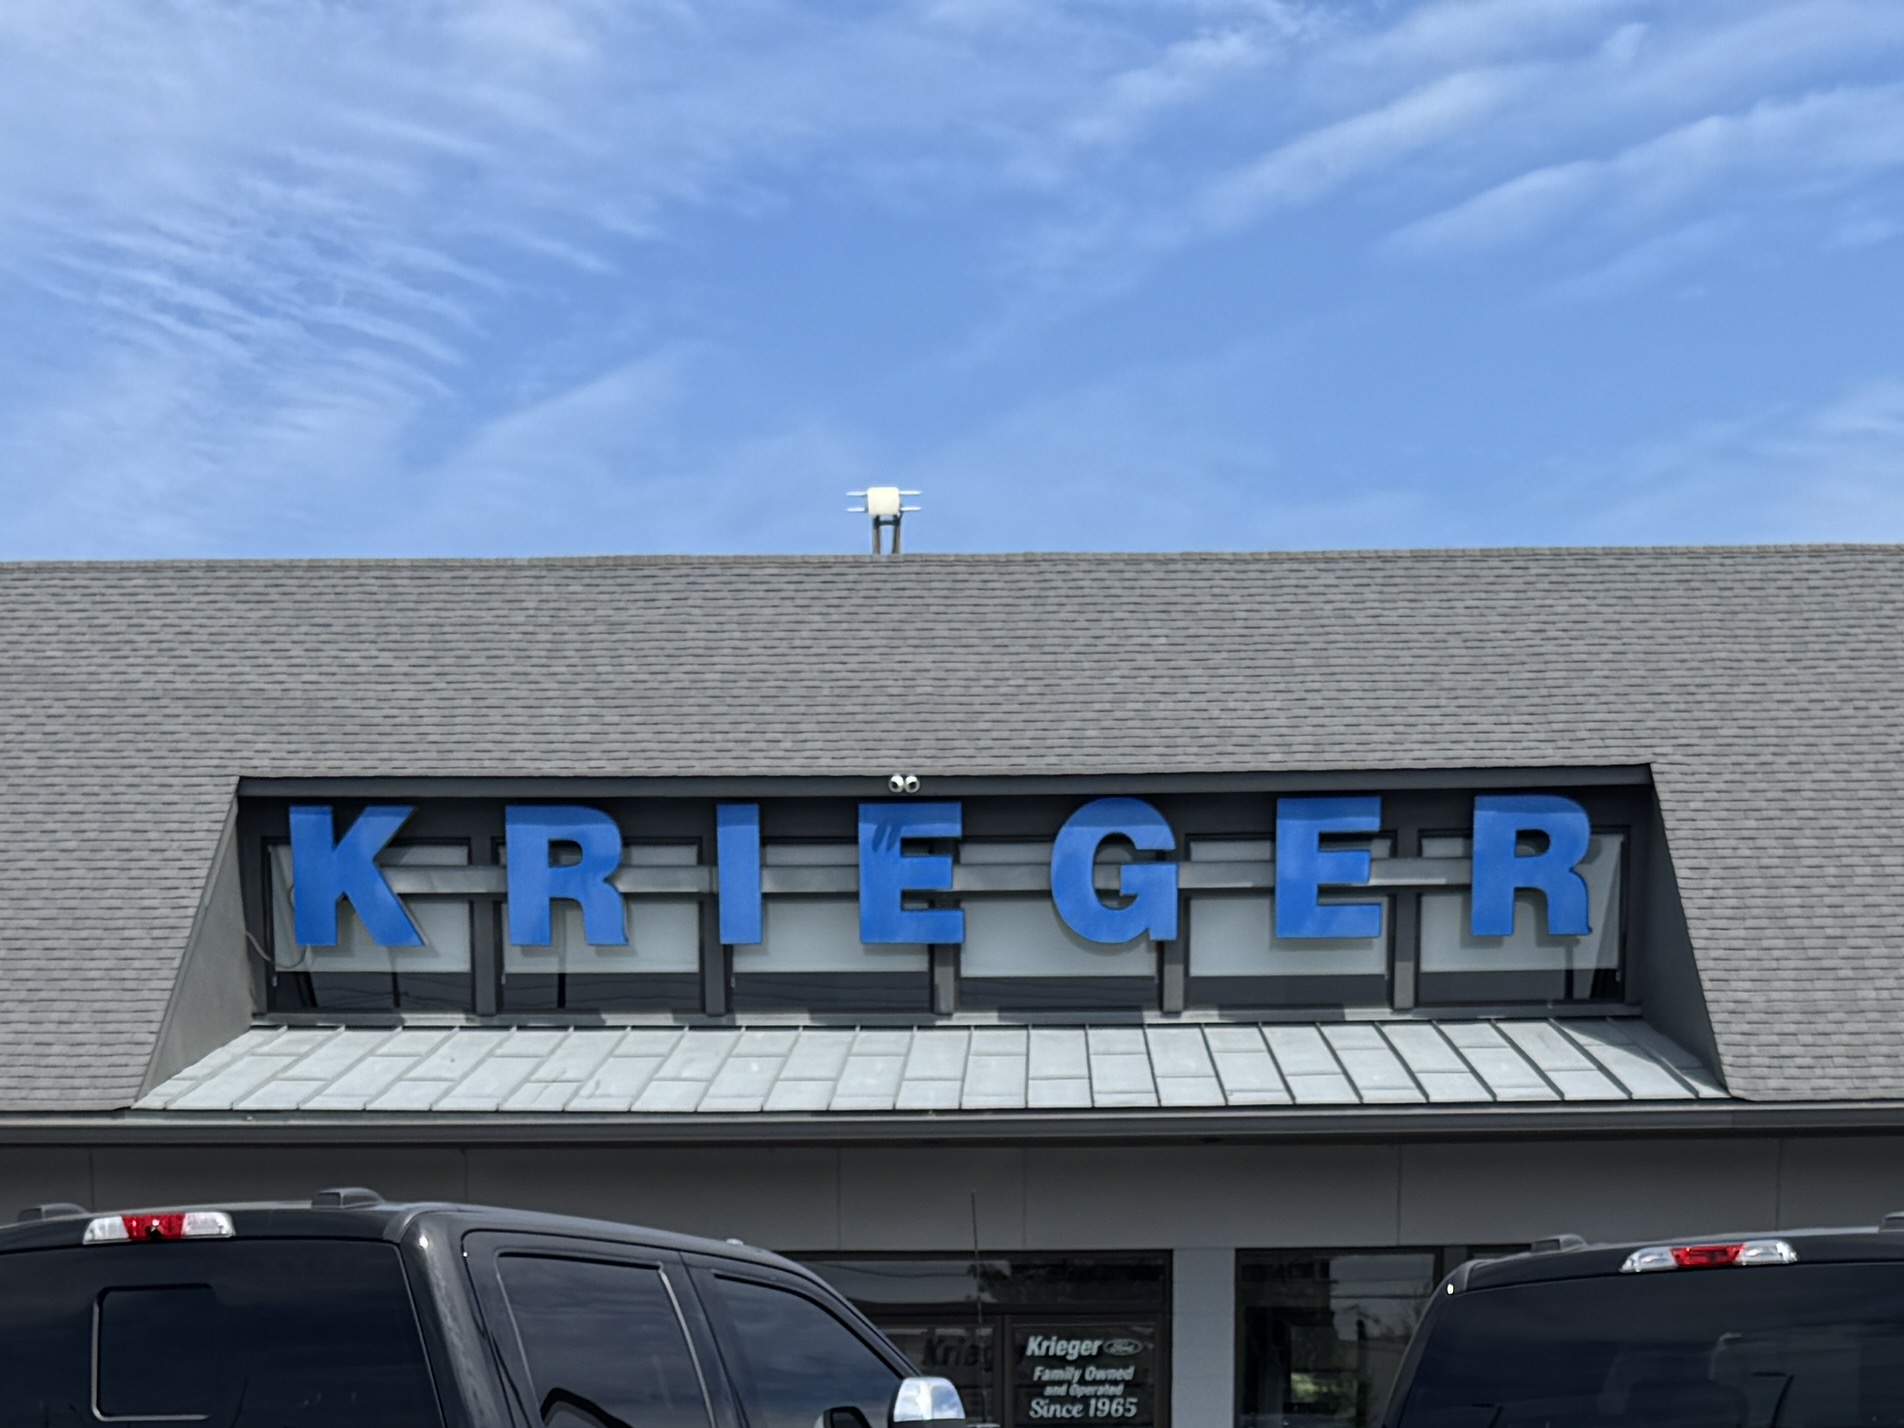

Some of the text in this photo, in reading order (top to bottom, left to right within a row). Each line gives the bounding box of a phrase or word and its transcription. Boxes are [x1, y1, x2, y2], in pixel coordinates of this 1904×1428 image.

[288, 796, 1594, 948] KRIEGER
[1025, 1336, 1103, 1361] Krieger
[1032, 1366, 1134, 1383] Family Owned
[1043, 1384, 1068, 1396] and
[1029, 1398, 1138, 1418] Since 1965
